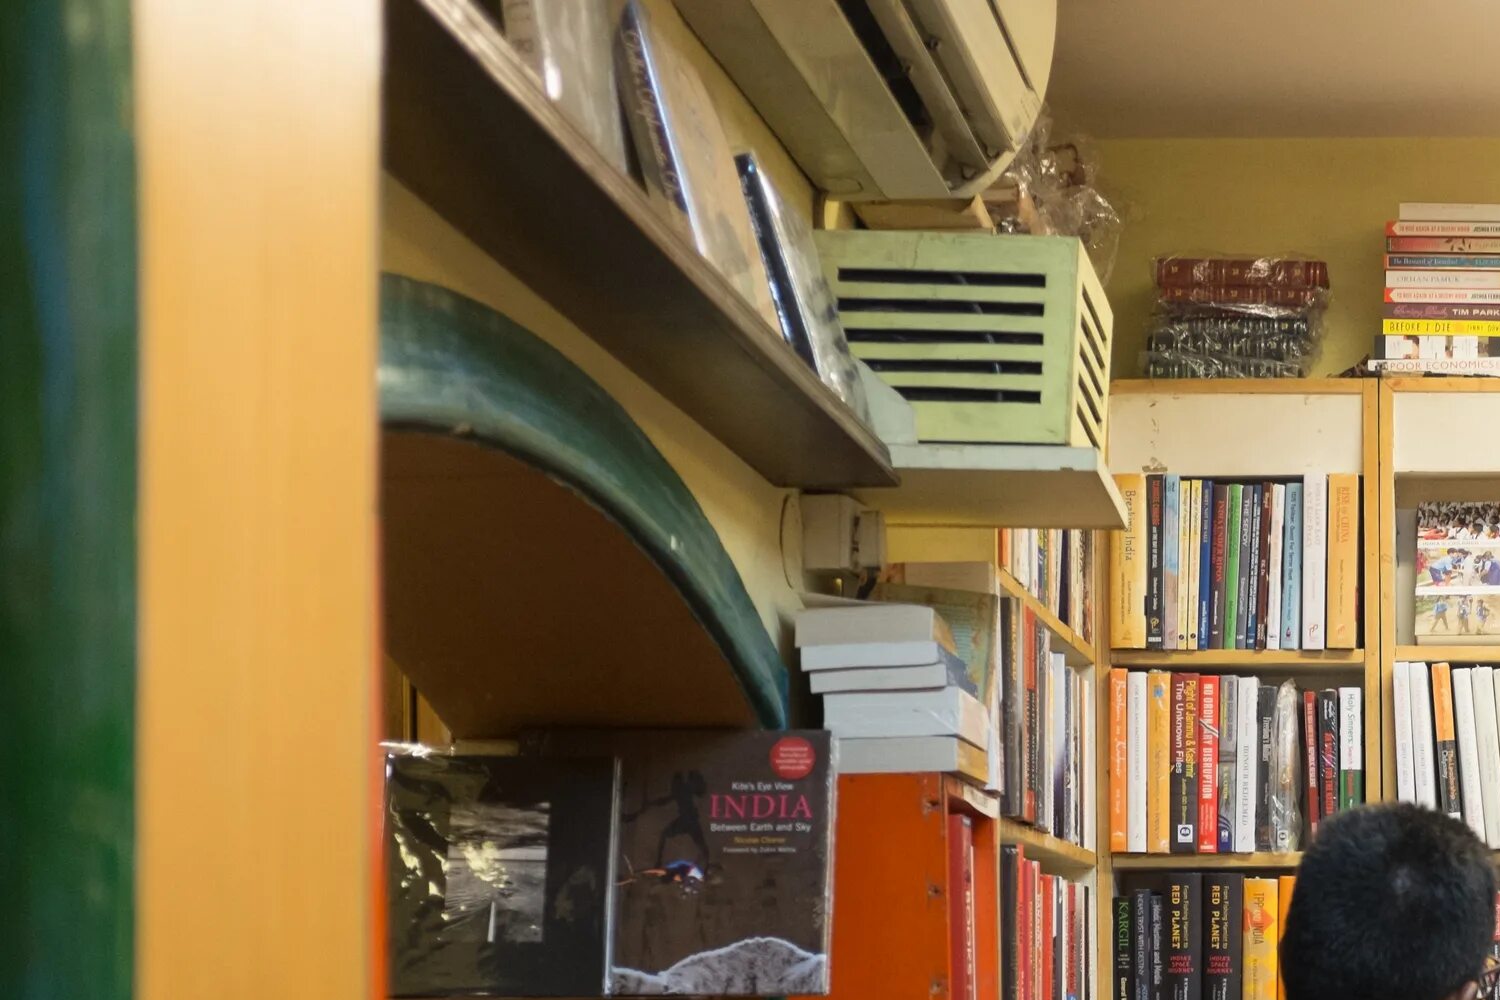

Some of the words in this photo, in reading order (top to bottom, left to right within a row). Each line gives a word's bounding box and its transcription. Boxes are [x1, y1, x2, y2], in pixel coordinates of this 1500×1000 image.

[1452, 308, 1469, 316] TIM
[1389, 321, 1420, 331] BEFORE
[1425, 322, 1430, 331] I
[1434, 320, 1450, 333] DIE
[1389, 360, 1421, 371] POOR
[1425, 359, 1496, 371] ECONOMICS
[1123, 490, 1136, 533] Breaking
[1242, 518, 1251, 547] SEPOY
[1124, 535, 1136, 561] India
[1176, 681, 1184, 700] The
[1184, 680, 1196, 699] Plight
[1203, 683, 1213, 695] NO
[1185, 702, 1196, 711] of
[1346, 693, 1355, 711] Holy
[1175, 703, 1185, 748] Unknown
[1185, 711, 1196, 739] Jammu
[1346, 713, 1355, 744] Sinners:
[1175, 750, 1184, 774] Files
[1185, 747, 1195, 779] Kashmir
[1202, 747, 1213, 799] DISRUPTION
[710, 794, 813, 819] INDIA
[710, 823, 747, 832] Between
[750, 822, 773, 831] Earth
[776, 822, 793, 831] and
[795, 822, 811, 833] Sky
[1171, 885, 1181, 905] RED
[1211, 886, 1220, 905] RED
[1119, 901, 1130, 950] KARGIL
[1171, 910, 1181, 950] PLANET
[1211, 910, 1220, 950] PLANET
